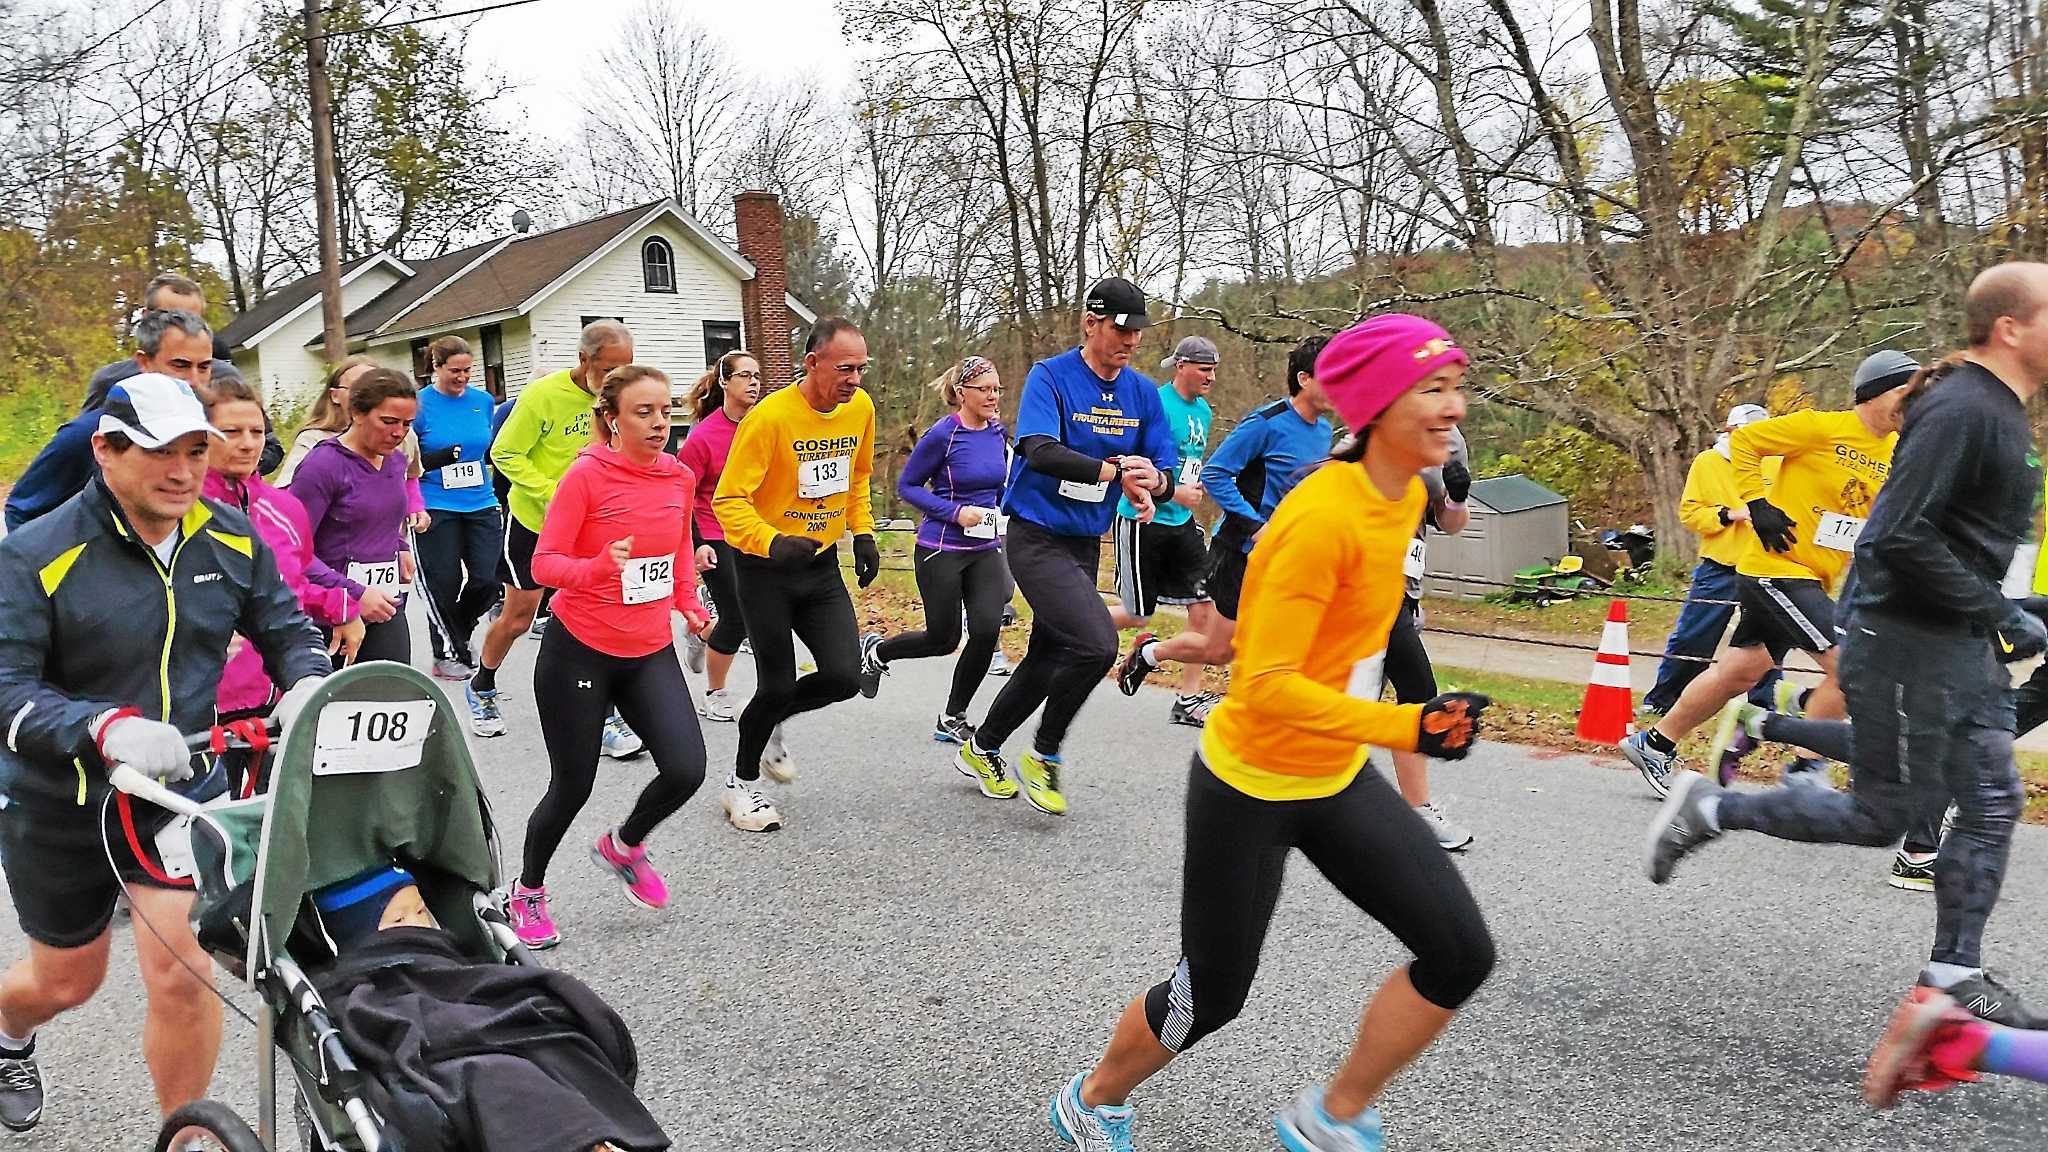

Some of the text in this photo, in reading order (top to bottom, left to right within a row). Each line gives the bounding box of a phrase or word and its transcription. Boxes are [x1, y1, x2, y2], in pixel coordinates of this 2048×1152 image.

[792, 436, 858, 452] GOSHEN
[797, 450, 833, 462] TURKEY
[1835, 444, 1889, 475] GOSHE
[452, 465, 474, 478] 119
[812, 461, 838, 482] 133
[806, 521, 828, 532] 2009
[979, 512, 995, 527] 39
[1835, 519, 1857, 537] 17
[365, 566, 395, 586] 176
[639, 560, 669, 583] 152
[347, 711, 409, 742] 108
